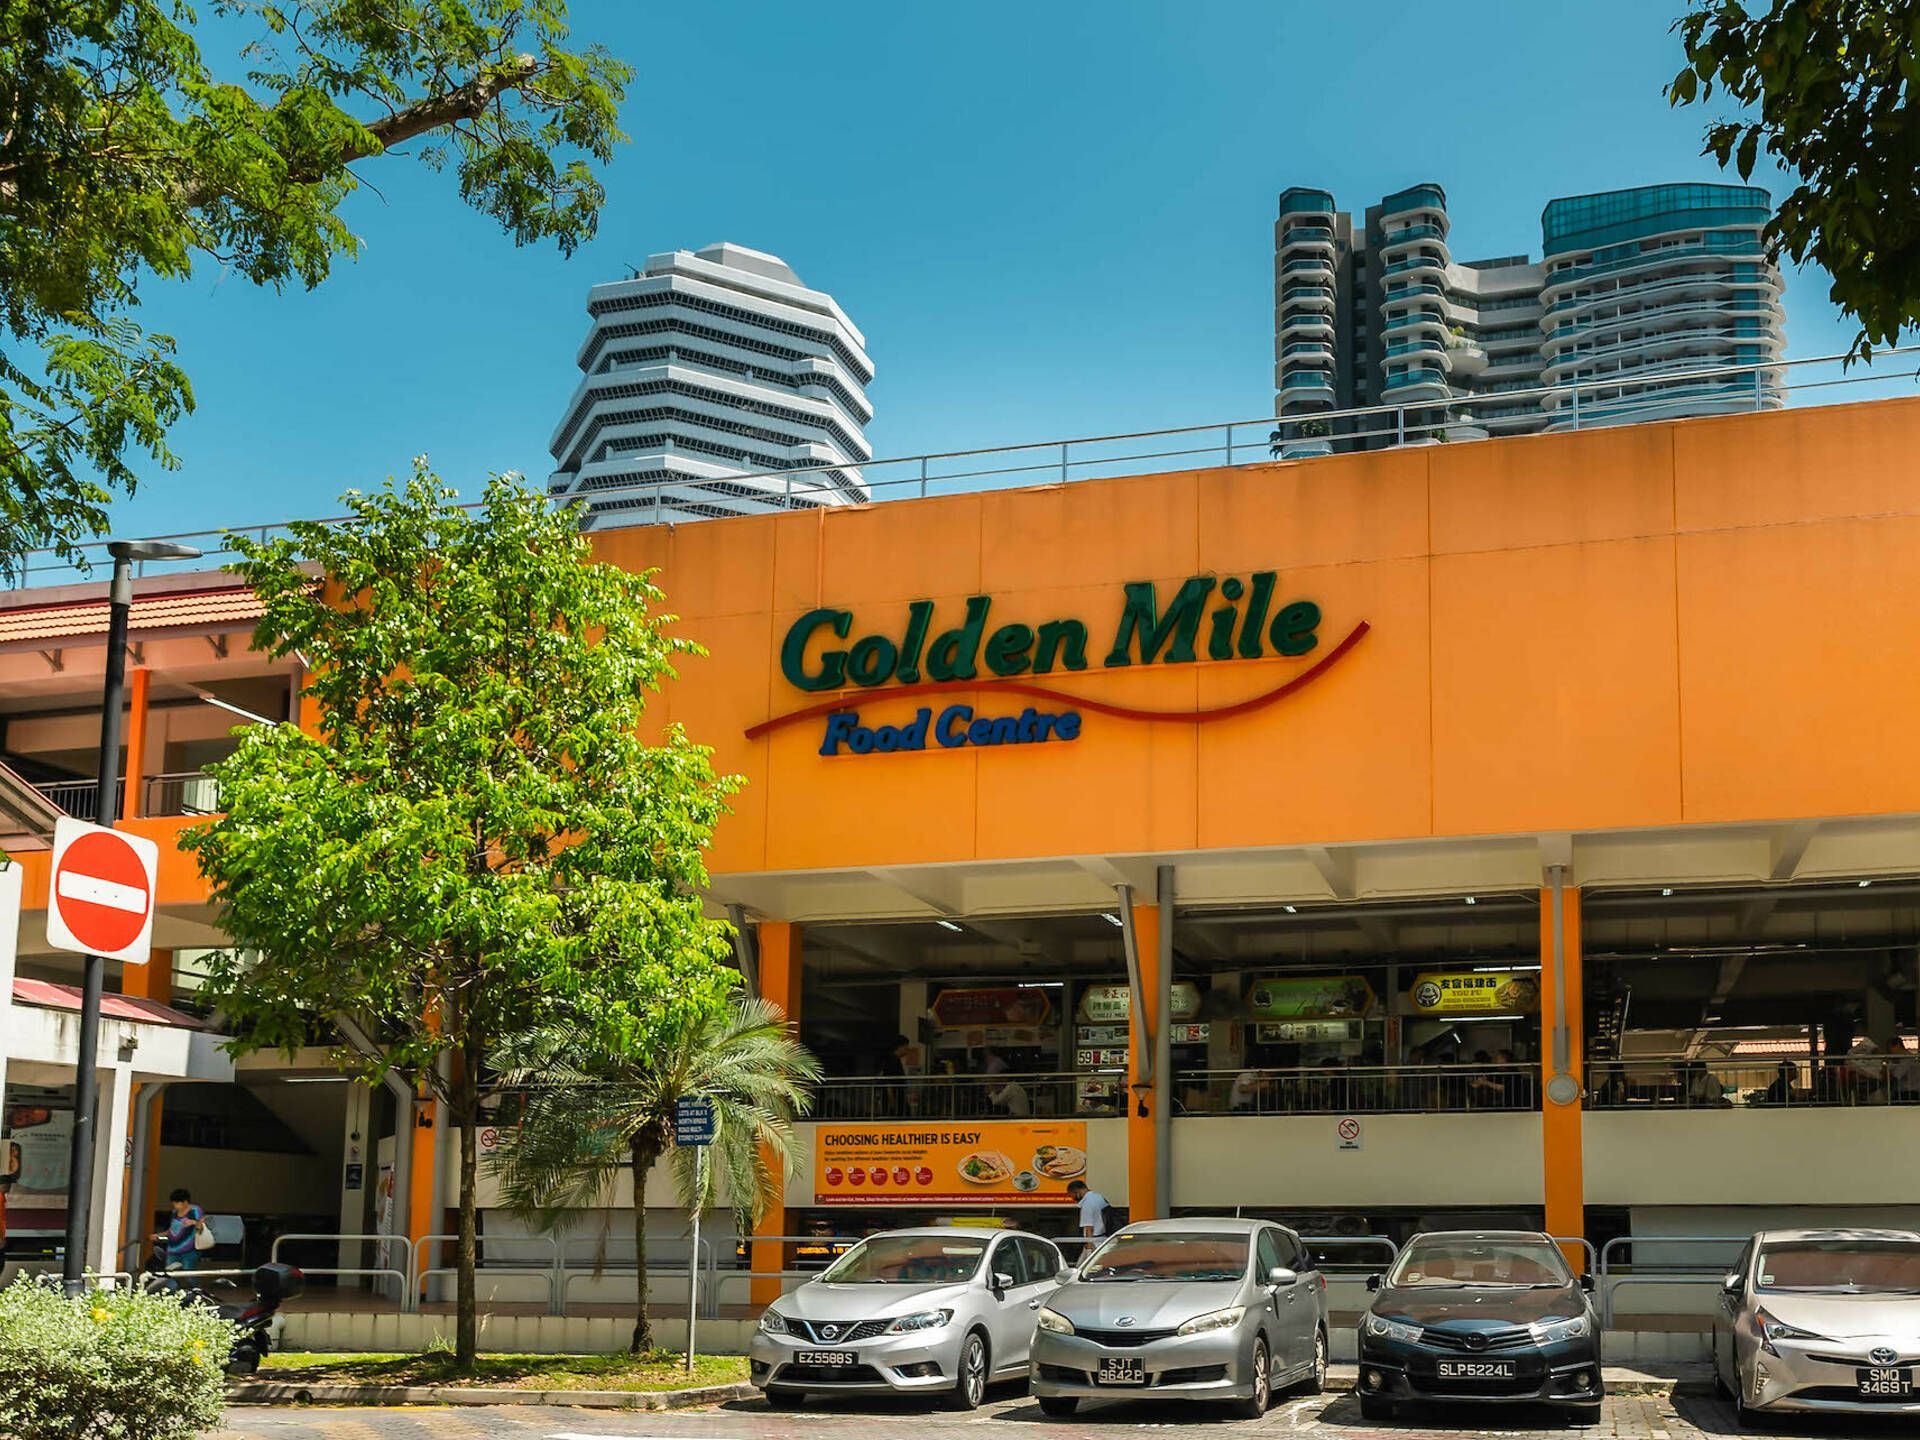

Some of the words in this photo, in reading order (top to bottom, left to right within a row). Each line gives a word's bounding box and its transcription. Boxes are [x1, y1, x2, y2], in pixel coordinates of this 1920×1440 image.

[780, 595, 1087, 691] Golden
[1104, 571, 1322, 667] Mile
[819, 708, 931, 756] Food
[936, 704, 1082, 748] Centre
[1078, 1051, 1092, 1064] 59
[824, 1134, 879, 1146] CHOOSING
[882, 1133, 938, 1145] HEALTHIER
[941, 1133, 950, 1144] IS
[953, 1132, 981, 1144] EASY
[798, 1352, 853, 1364] EZ5588S
[1108, 1358, 1133, 1369] SJT
[1100, 1369, 1142, 1381] 9642P
[1439, 1363, 1513, 1376] SLP5224L
[1870, 1368, 1900, 1381] SMQ
[1860, 1381, 1911, 1394] 3469T
